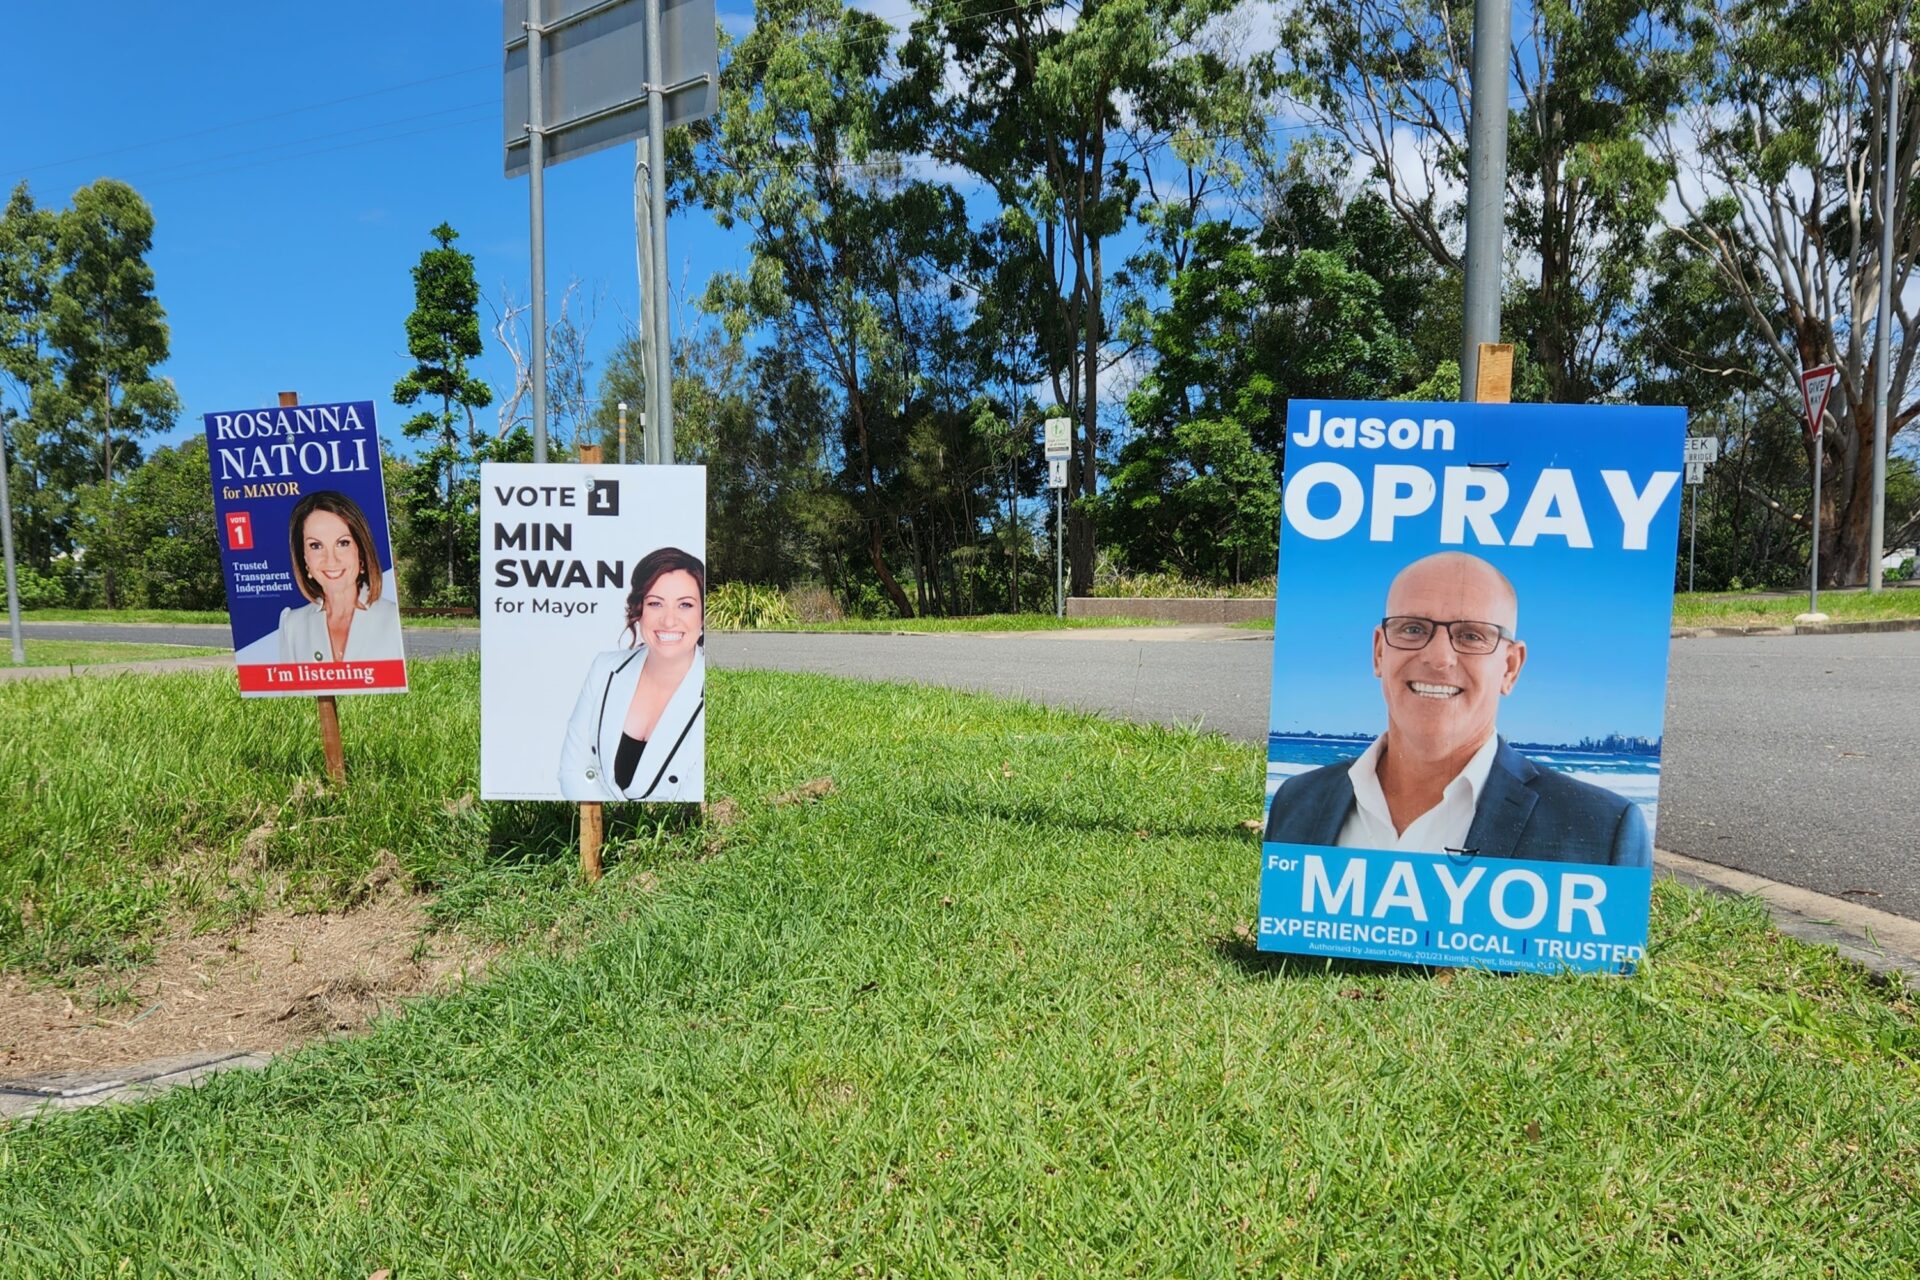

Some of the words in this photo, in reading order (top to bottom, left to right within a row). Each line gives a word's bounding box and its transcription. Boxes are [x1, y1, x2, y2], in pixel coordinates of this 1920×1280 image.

[1808, 379, 1825, 394] GIVE
[214, 405, 365, 440] ROSANNA
[1292, 409, 1456, 451] Jason
[218, 438, 370, 480] NATOLI
[1688, 453, 1713, 461] BRIDGE
[222, 486, 241, 500] for
[243, 481, 300, 499] MAYOR
[494, 486, 576, 507] VOTE
[596, 488, 611, 508] 1
[1284, 461, 1681, 551] OPRAY
[229, 516, 247, 524] VOTE
[234, 525, 245, 545] 1
[494, 522, 572, 552] MIN
[232, 560, 269, 571] Trusted
[494, 558, 624, 589] SWAN
[234, 571, 290, 584] Transparent
[235, 582, 293, 595] Independent
[494, 597, 525, 613] for
[532, 598, 598, 618] Mayor
[266, 667, 294, 682] I'm
[298, 664, 375, 684] listening
[1268, 855, 1299, 871] For
[1301, 854, 1608, 936] MAYOR
[1259, 917, 1418, 946] EXPERIENCED
[1437, 931, 1515, 955] LOCAL
[1534, 938, 1643, 964] TRUSTED
[1309, 942, 1351, 953] Authorised
[1352, 945, 1363, 955] by
[1364, 947, 1387, 955] Jason
